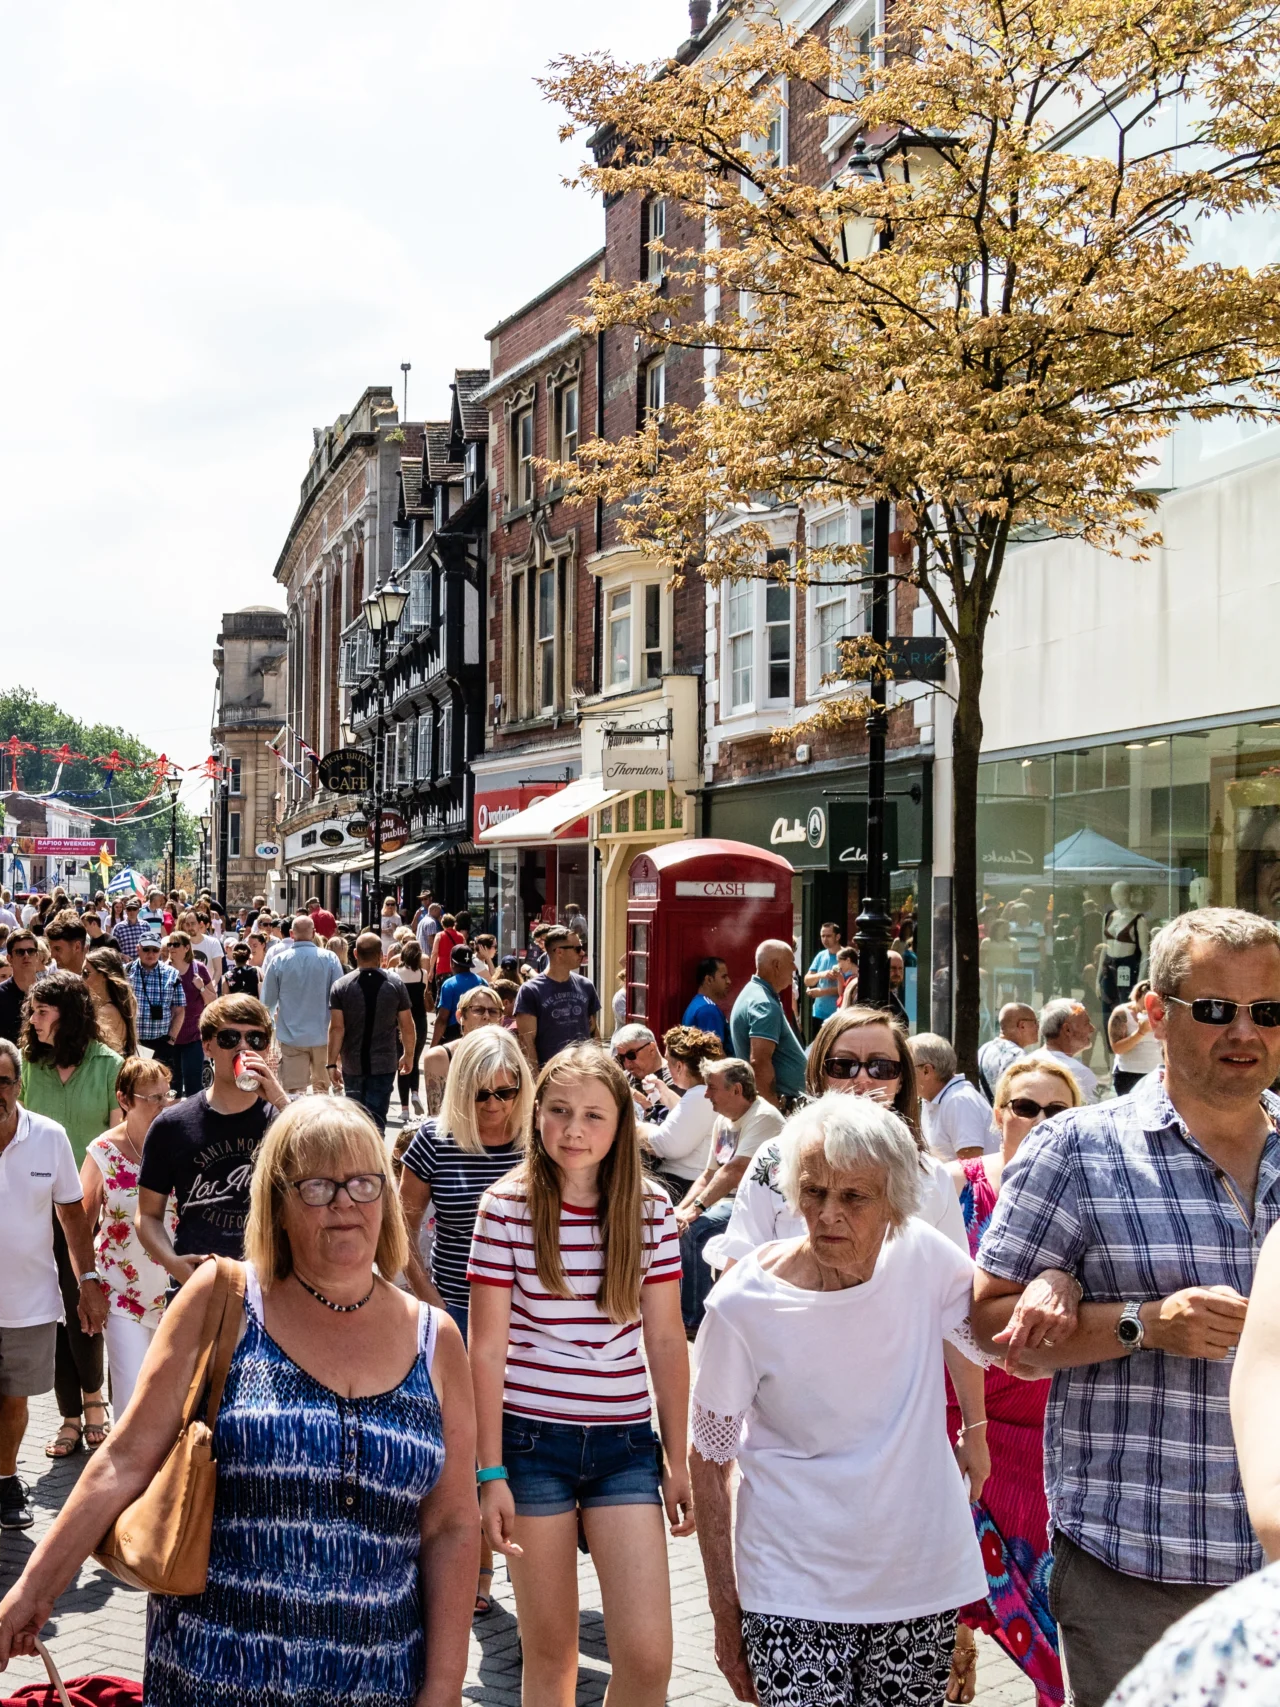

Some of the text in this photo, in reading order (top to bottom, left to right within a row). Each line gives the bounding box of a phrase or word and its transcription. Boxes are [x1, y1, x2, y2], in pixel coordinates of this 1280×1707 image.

[321, 753, 344, 770] HIGH
[606, 761, 664, 778] Thorntons
[370, 818, 395, 832] Psty
[372, 827, 408, 842] epublic
[839, 846, 889, 862] Clas
[703, 882, 746, 896] CASH
[193, 1139, 233, 1168] SANTA
[201, 1207, 248, 1230] CALIFO
